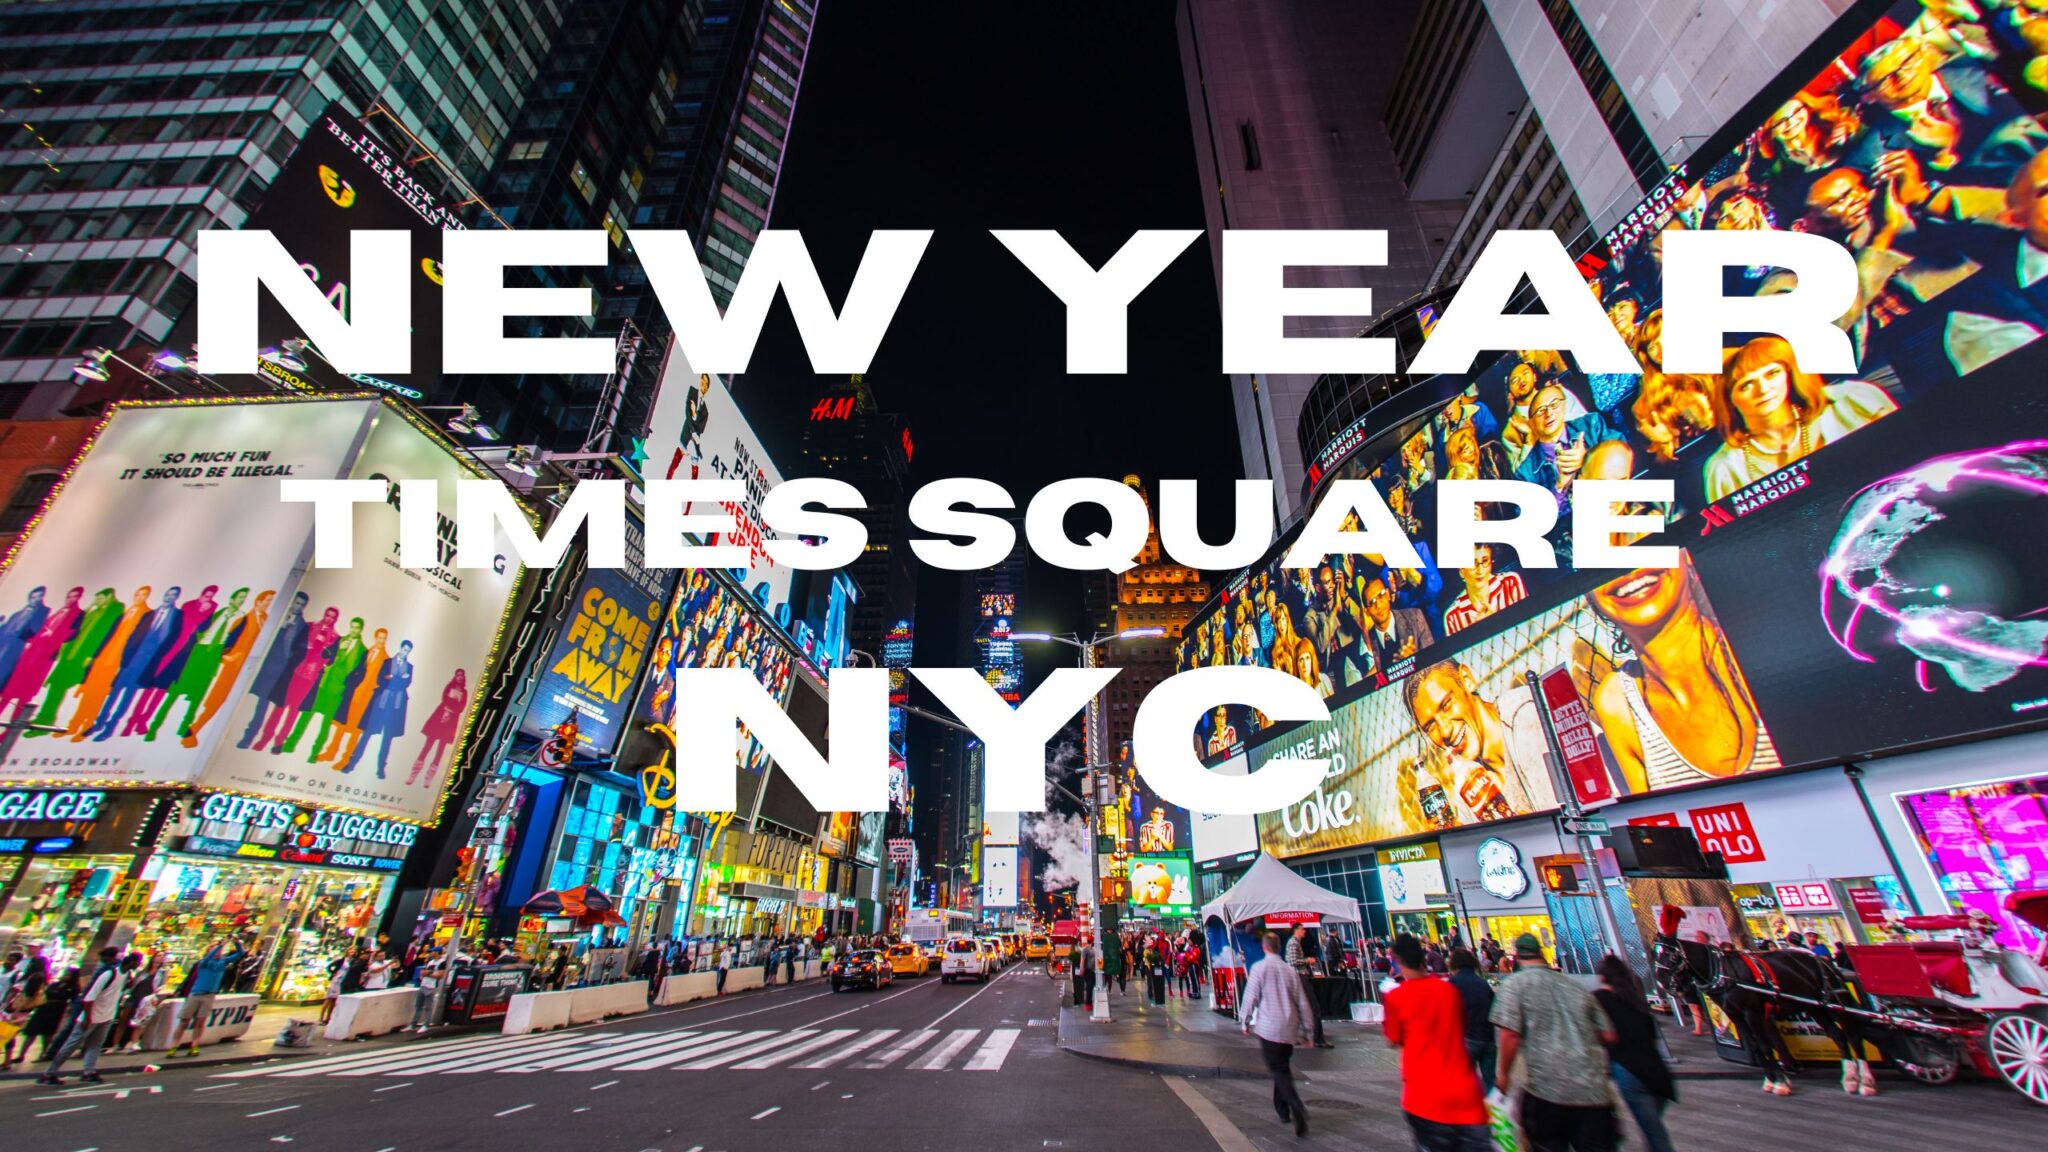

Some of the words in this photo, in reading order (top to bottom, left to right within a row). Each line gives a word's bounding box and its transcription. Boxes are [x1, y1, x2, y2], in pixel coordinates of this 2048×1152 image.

[326, 118, 393, 184] BETTER
[397, 181, 440, 224] THAN
[359, 134, 392, 167] IT'S
[393, 164, 435, 206] BACK
[1604, 164, 1688, 245] MARRIOTT
[1610, 185, 1685, 255] MARQUIS
[810, 396, 855, 422] H&M
[734, 437, 750, 465] NOW
[1321, 418, 1366, 461] MARRIOTT
[1323, 433, 1362, 470] MARQUIS
[190, 451, 236, 463] MUCH
[240, 450, 271, 462] FUN
[711, 454, 728, 479] AT
[120, 469, 139, 480] IT
[142, 467, 203, 480] SHOULD
[205, 466, 228, 478] BE
[1731, 460, 1809, 504] MARRIOTT
[1736, 476, 1806, 515] MARQUIS
[583, 587, 651, 651] COME
[551, 647, 633, 704] AWAY
[1387, 656, 1416, 675] MARRIOTT
[1002, 692, 1020, 702] HIBA
[1318, 727, 1341, 753] AN
[29, 758, 121, 767] BROADWAY
[264, 770, 299, 783] NOW
[308, 778, 328, 789] ON
[335, 784, 403, 805] BROADWAY
[0, 792, 106, 820] GAGE
[202, 793, 295, 829] GIFTS
[308, 810, 420, 847] LUGGAGE
[1575, 819, 1589, 831] ONE
[1590, 820, 1604, 831] WAY
[1696, 811, 1742, 834] UNI
[236, 843, 277, 858] Nikon
[279, 849, 325, 864] Canon
[331, 853, 372, 867] SONY
[314, 833, 341, 850] NY
[1389, 845, 1428, 862] INVICTA
[108, 881, 131, 914] ATM
[128, 881, 152, 914] ATM
[1740, 895, 1775, 909] op-Up
